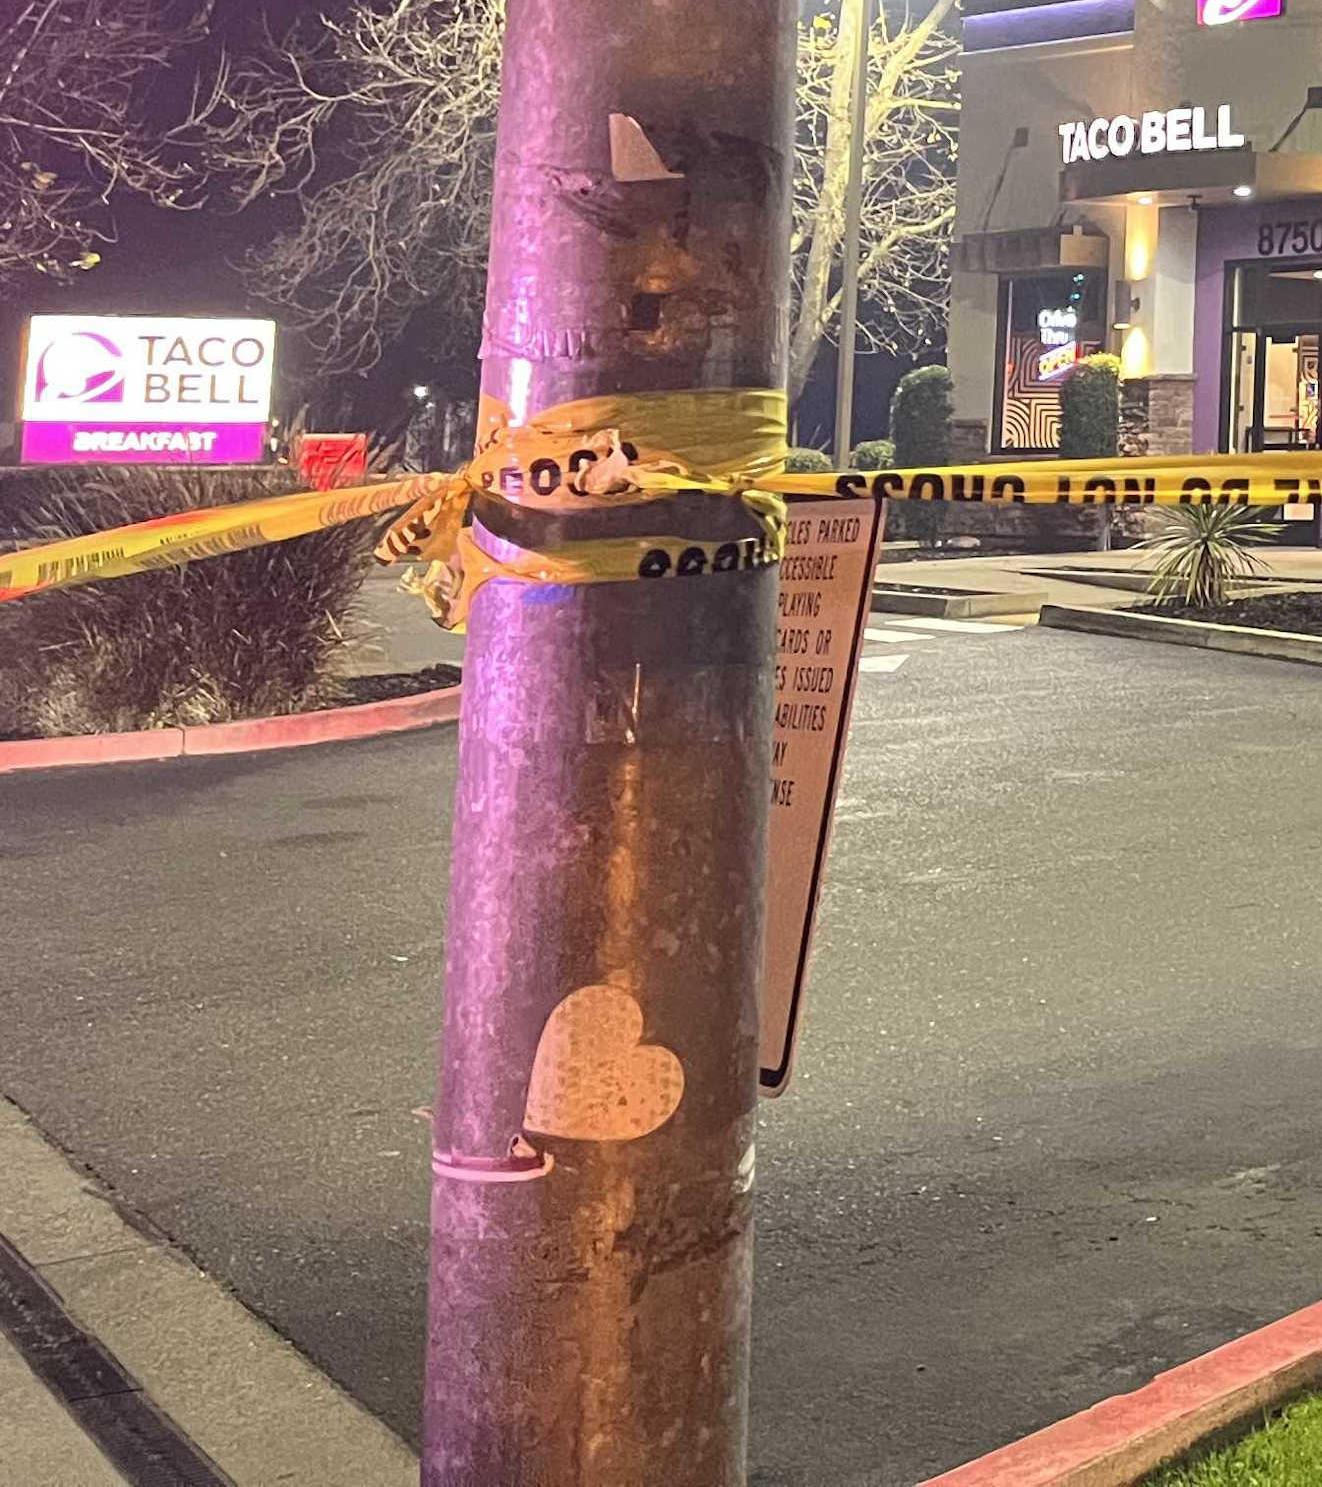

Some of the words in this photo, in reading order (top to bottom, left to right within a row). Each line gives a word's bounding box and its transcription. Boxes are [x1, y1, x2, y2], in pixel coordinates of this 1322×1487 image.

[1058, 115, 1136, 164] TACO
[1140, 104, 1245, 154] BELL
[138, 336, 265, 368] TACO
[144, 373, 259, 403] BELL
[73, 431, 217, 451] BREAKFAST
[785, 520, 811, 545] CLES
[817, 518, 860, 543] PARKED
[779, 555, 838, 580] CCESSIBLE
[778, 592, 822, 617] PLAYING
[777, 628, 810, 654] ARDS
[816, 629, 832, 655] OR
[792, 667, 834, 693] ISSUED
[775, 703, 827, 731] ABILITIES
